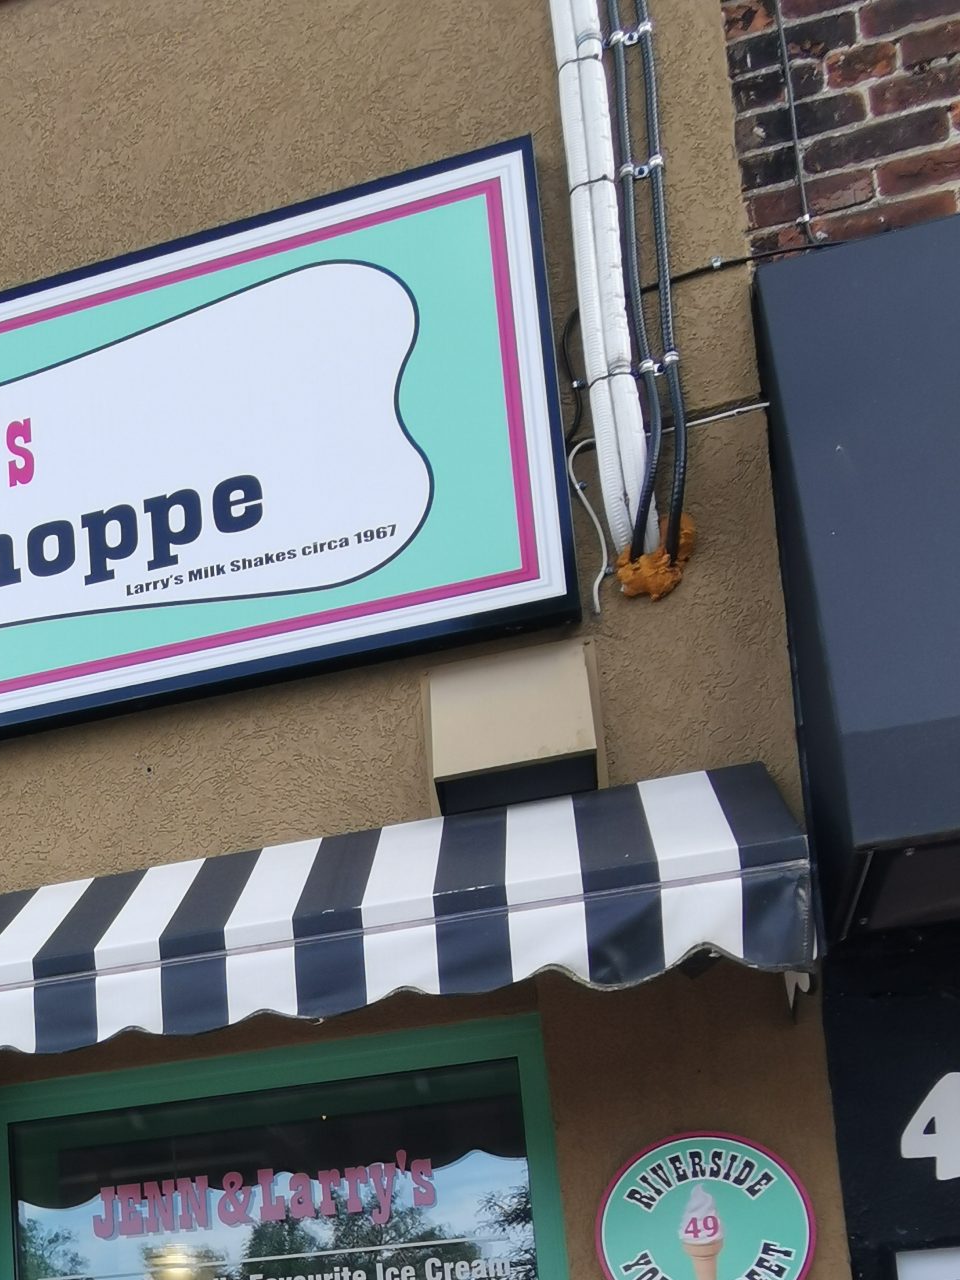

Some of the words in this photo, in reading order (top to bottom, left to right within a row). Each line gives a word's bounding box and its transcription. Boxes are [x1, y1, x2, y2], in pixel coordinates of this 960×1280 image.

[126, 571, 184, 597] Larry's
[188, 560, 227, 582] Milk
[230, 547, 297, 574] Shakes
[301, 535, 350, 556] circa
[354, 524, 397, 545] 1967
[93, 1174, 210, 1241] JENN
[217, 1170, 255, 1227] &
[257, 1149, 438, 1225] Larry's
[626, 1150, 775, 1211] RIVERSIDE
[684, 1215, 719, 1239] 49
